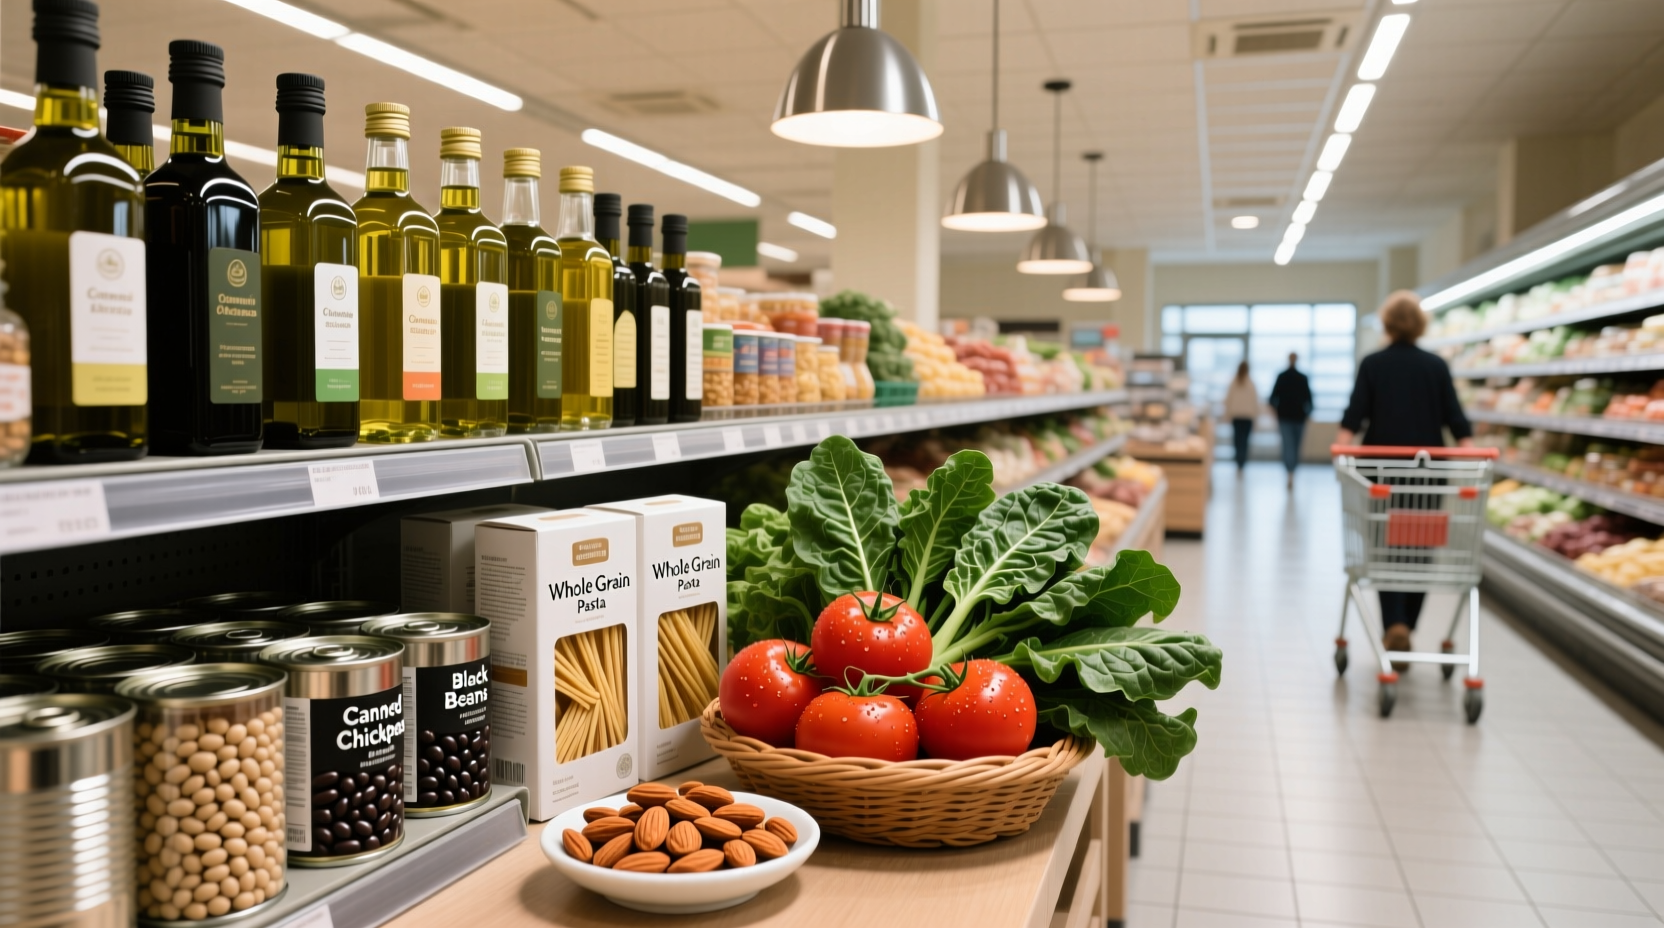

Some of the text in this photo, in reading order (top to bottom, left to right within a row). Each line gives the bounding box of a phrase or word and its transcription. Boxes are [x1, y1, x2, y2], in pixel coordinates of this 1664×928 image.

[652, 553, 721, 580] Whole Grain
[548, 572, 630, 601] Whole Grain
[577, 597, 607, 614] Pasta
[452, 664, 489, 690] Black
[343, 693, 402, 726] Canned
[444, 688, 488, 710] Beans
